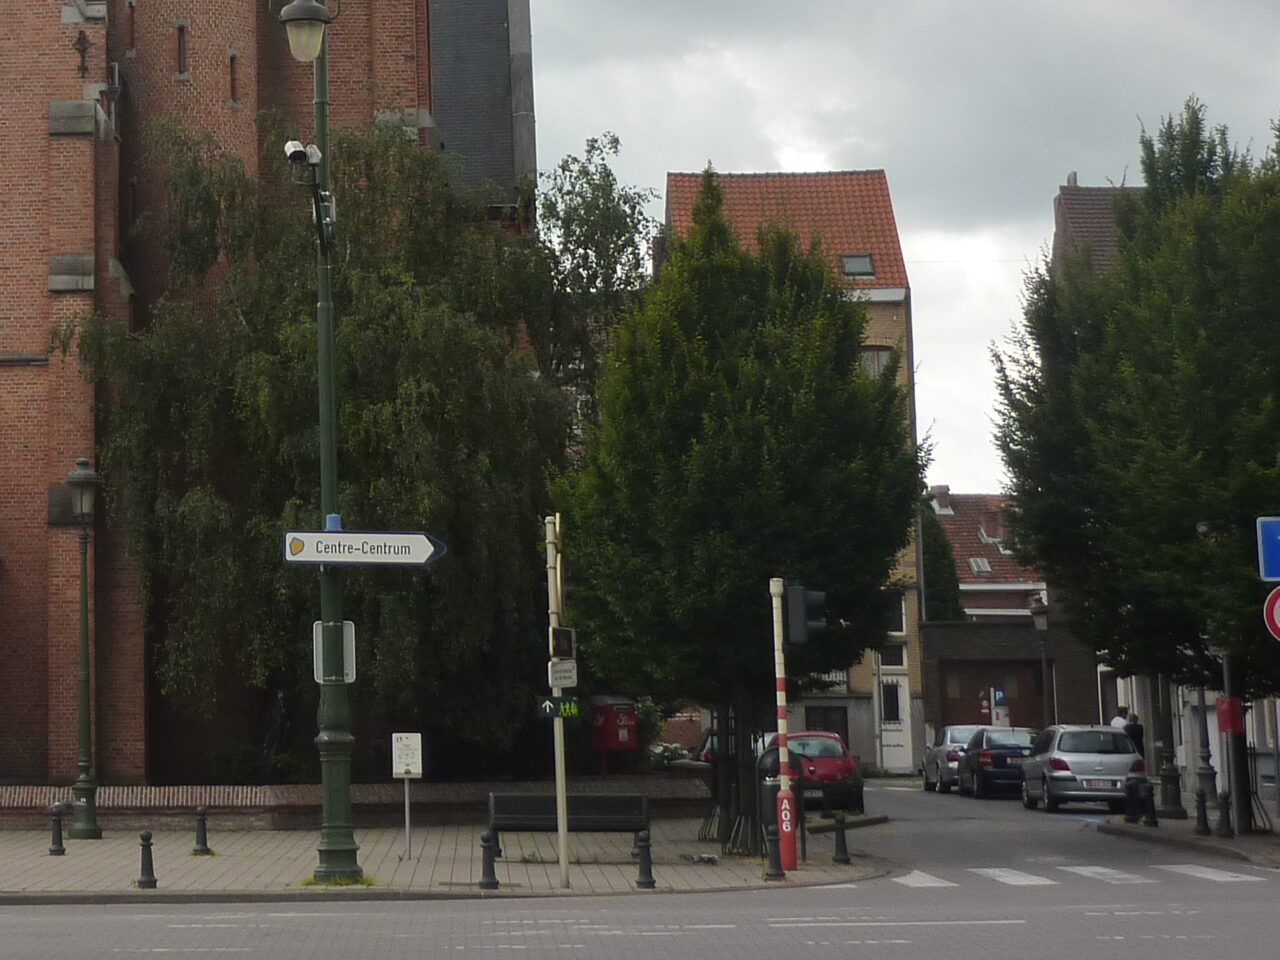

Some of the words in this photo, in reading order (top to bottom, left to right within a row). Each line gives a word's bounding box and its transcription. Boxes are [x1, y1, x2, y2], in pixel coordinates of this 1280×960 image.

[315, 541, 411, 555] Centre-Centrum
[995, 691, 1004, 701] P
[781, 799, 792, 832] A06
